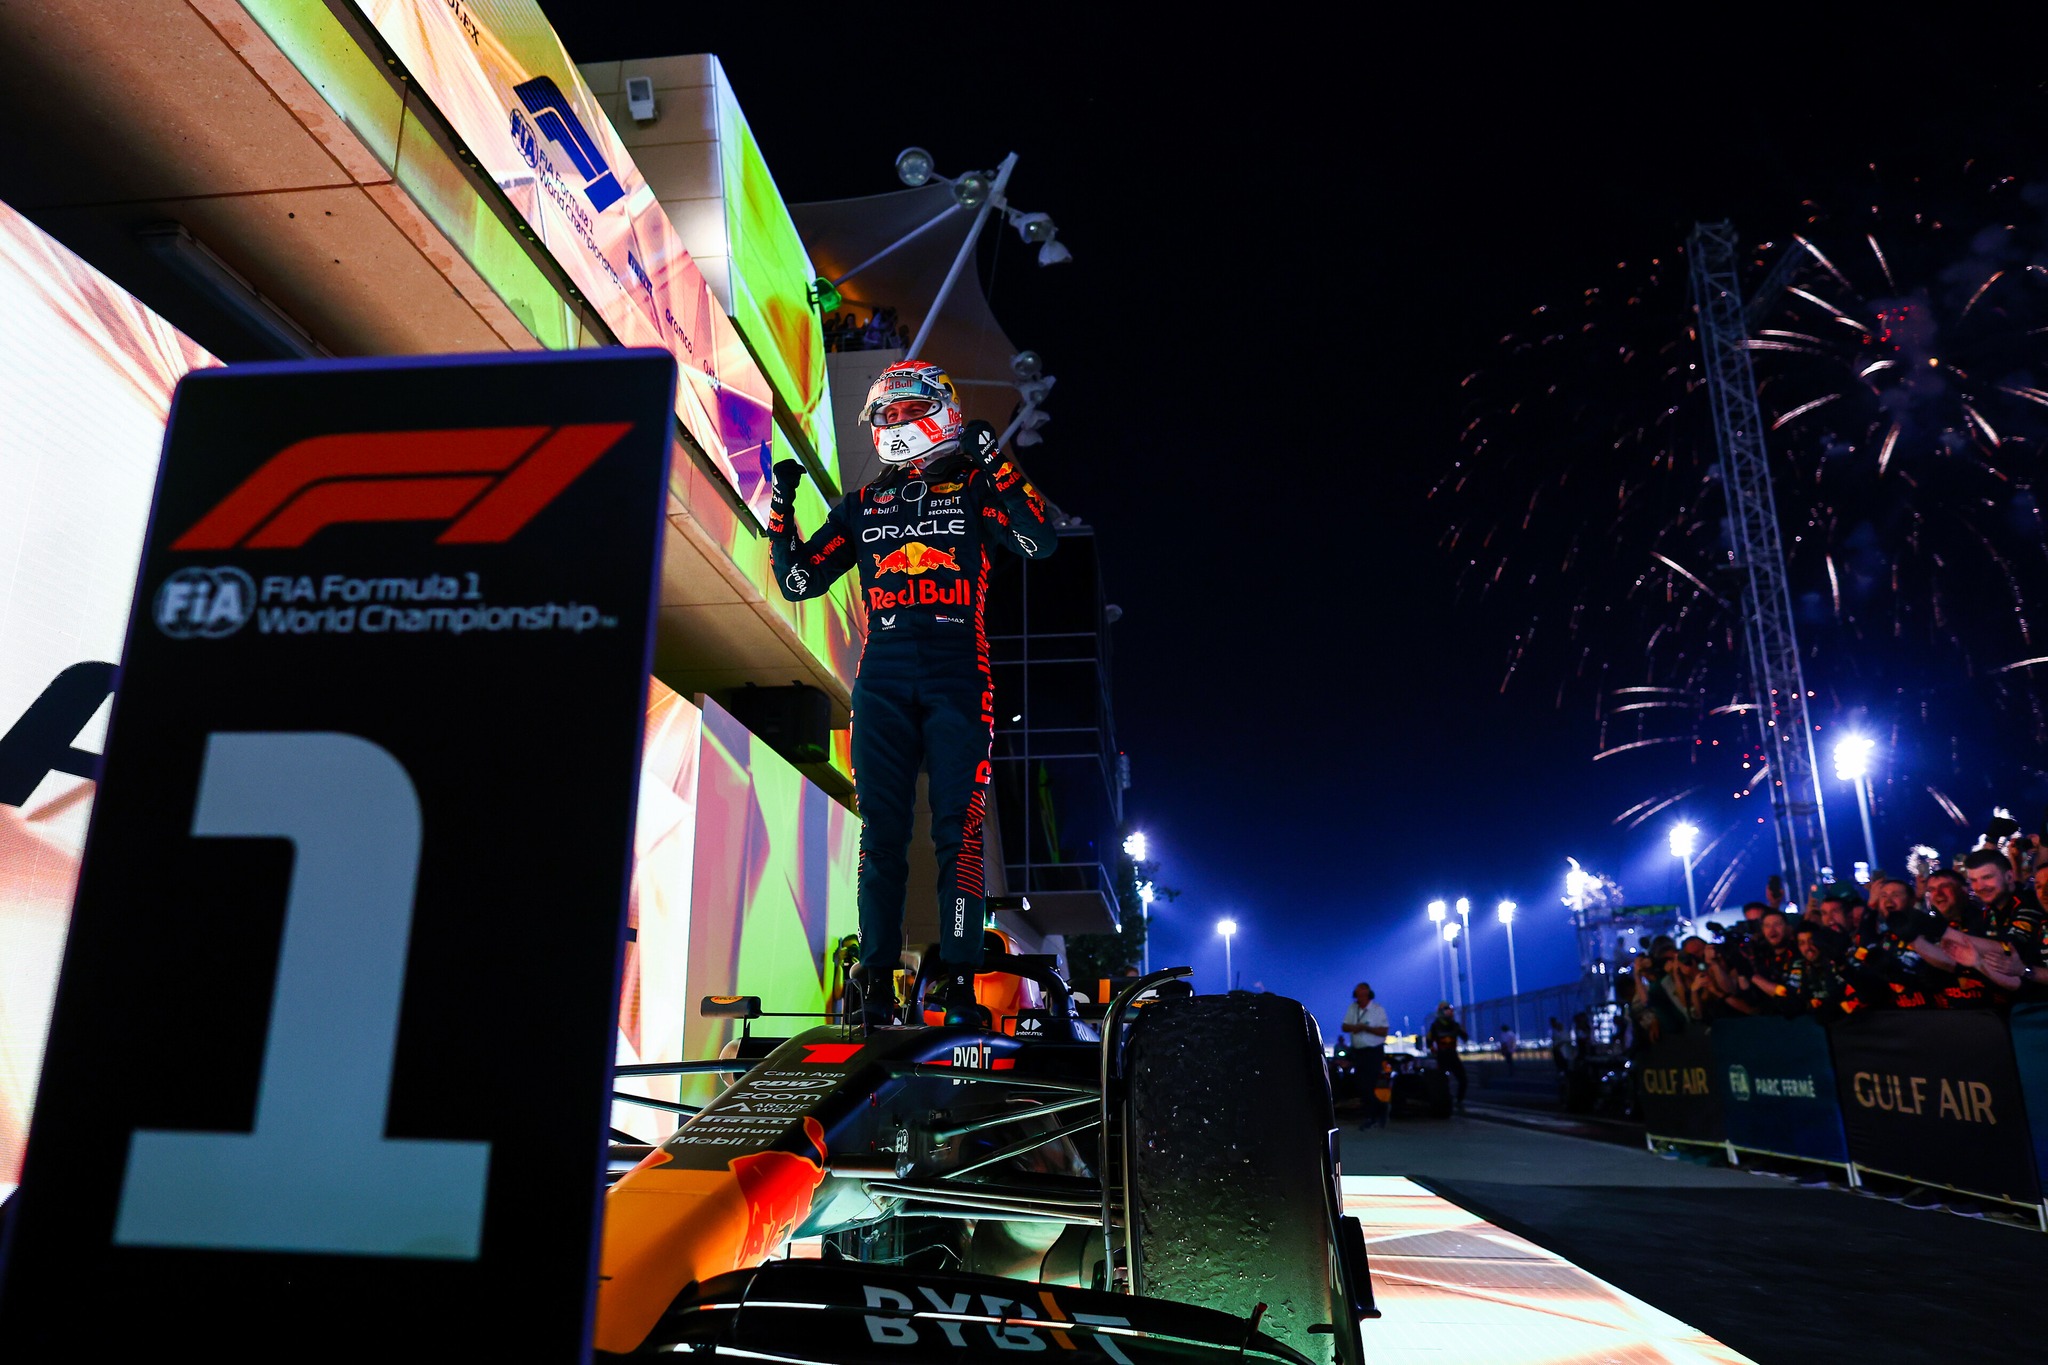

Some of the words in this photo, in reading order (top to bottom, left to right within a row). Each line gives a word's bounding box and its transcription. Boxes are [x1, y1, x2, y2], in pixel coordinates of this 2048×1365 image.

[538, 167, 566, 212] World
[539, 149, 555, 180] FIA
[554, 173, 589, 226] Formula
[665, 308, 693, 354] aramco
[168, 422, 636, 551] F1
[863, 507, 889, 516] Mobil
[928, 508, 964, 516] HONDA
[930, 496, 961, 508] BYBIT
[862, 519, 966, 543] ORACLE
[260, 575, 317, 600] FIA
[321, 573, 458, 600] Formula
[868, 579, 915, 611] Red
[919, 579, 971, 606] Bull
[257, 604, 355, 634] World
[114, 730, 492, 1260] 1
[809, 1070, 846, 1078] App
[1643, 1069, 1678, 1095] GULF
[1682, 1067, 1709, 1095] AIR
[1755, 1078, 1781, 1096] PARC
[1781, 1074, 1816, 1098] FERMÉ
[1854, 1072, 1927, 1115] GULF
[1939, 1078, 1997, 1125] AIR
[699, 1115, 798, 1125] PIRELLI
[671, 1136, 746, 1146] Mobil
[863, 1284, 1135, 1365] BYBIT
